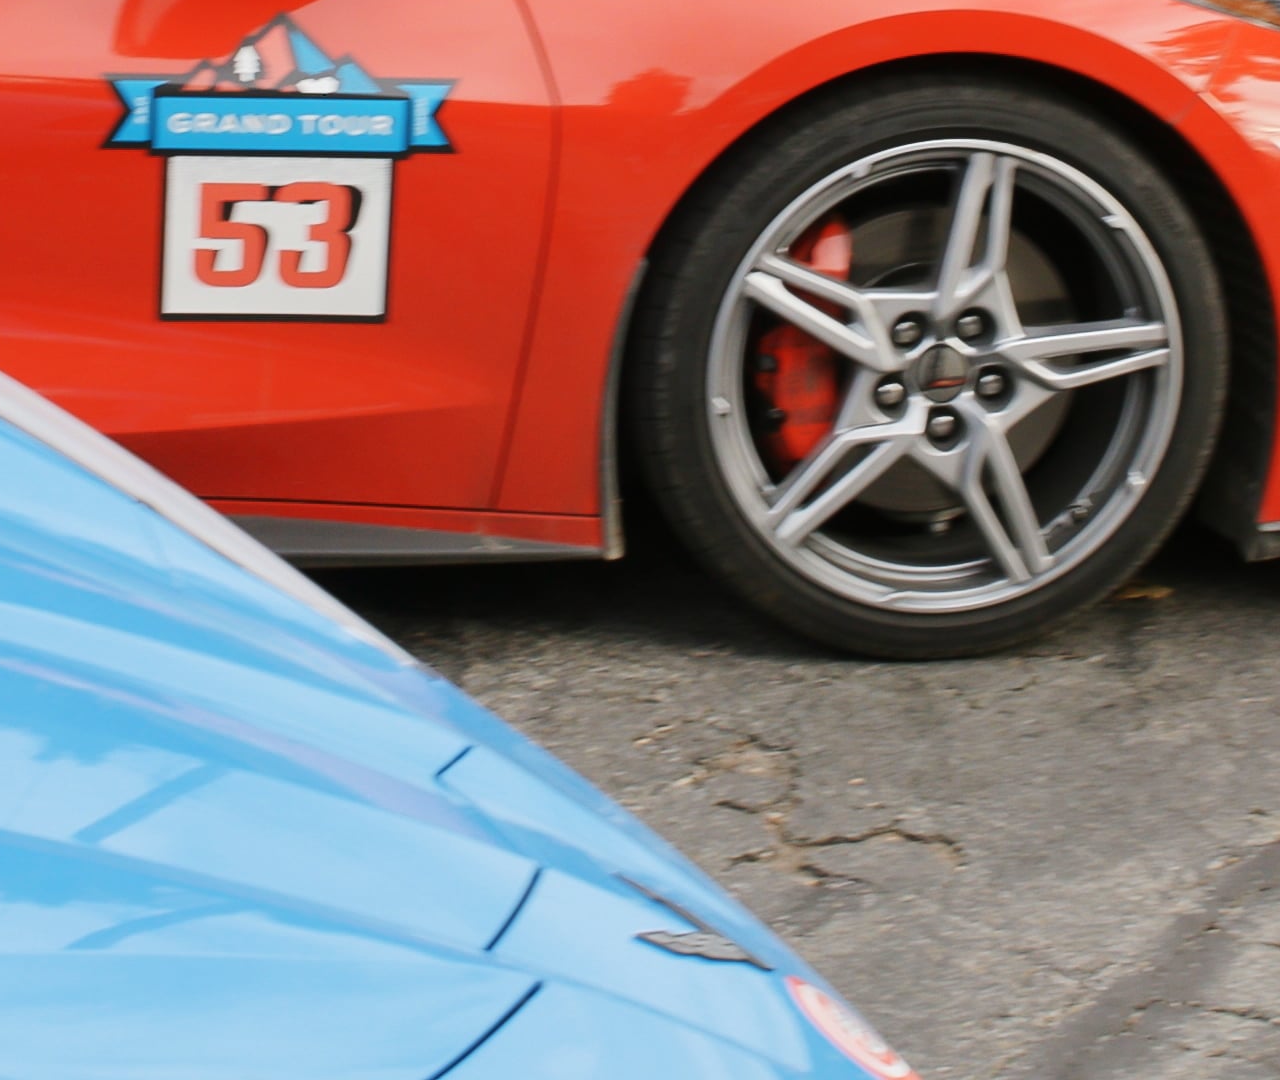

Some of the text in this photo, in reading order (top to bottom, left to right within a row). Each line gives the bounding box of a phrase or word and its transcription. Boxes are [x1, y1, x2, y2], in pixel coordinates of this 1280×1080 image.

[167, 112, 292, 135] GRAND
[298, 113, 395, 137] TOUR
[193, 181, 363, 289] 53
